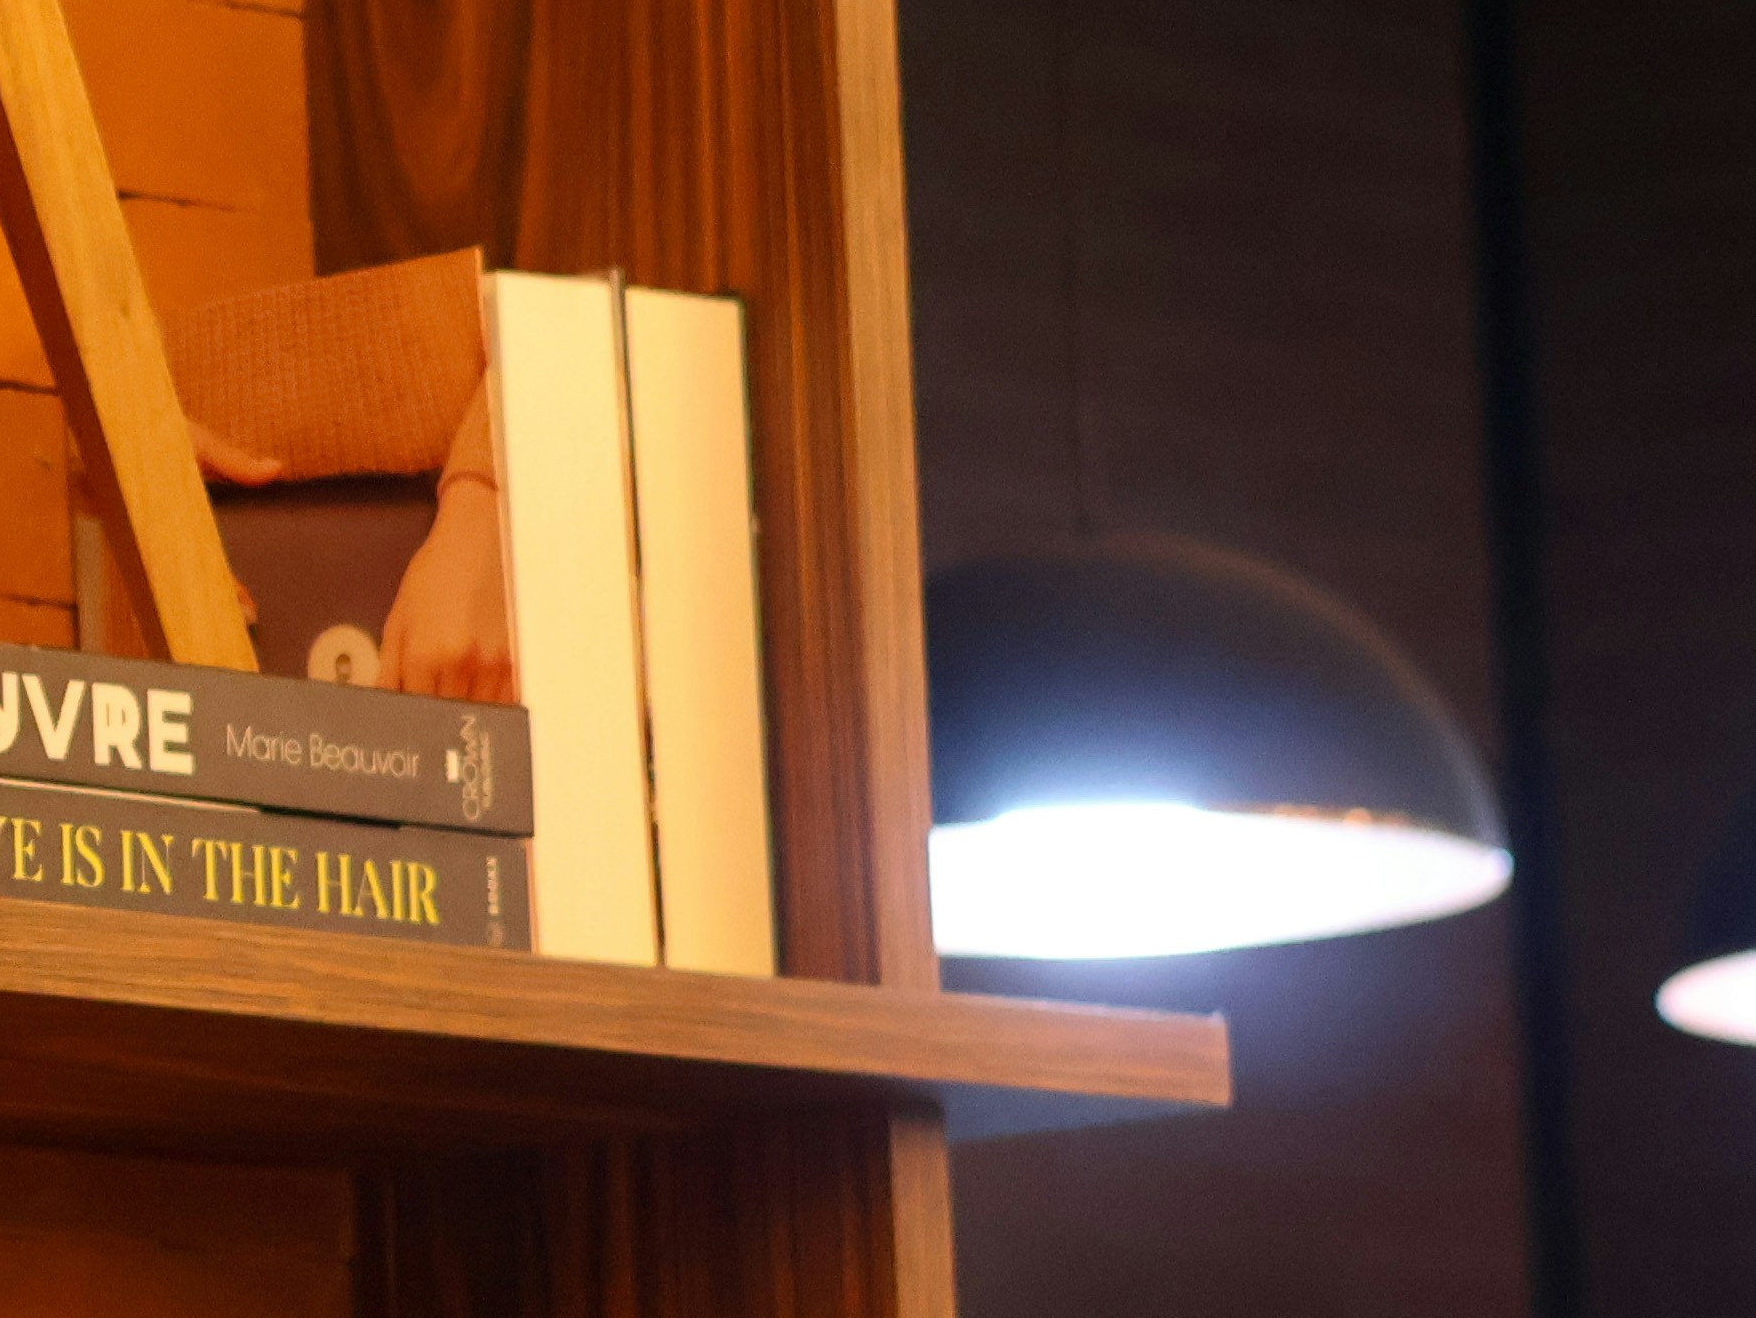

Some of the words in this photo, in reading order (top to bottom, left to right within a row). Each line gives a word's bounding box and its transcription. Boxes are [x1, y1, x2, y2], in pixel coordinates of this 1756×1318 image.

[225, 722, 301, 766] Marie
[309, 731, 420, 779] Beauvoir
[59, 822, 105, 888] IS
[120, 828, 175, 895] IN
[191, 837, 301, 910] THE
[314, 850, 441, 926] HAIR
